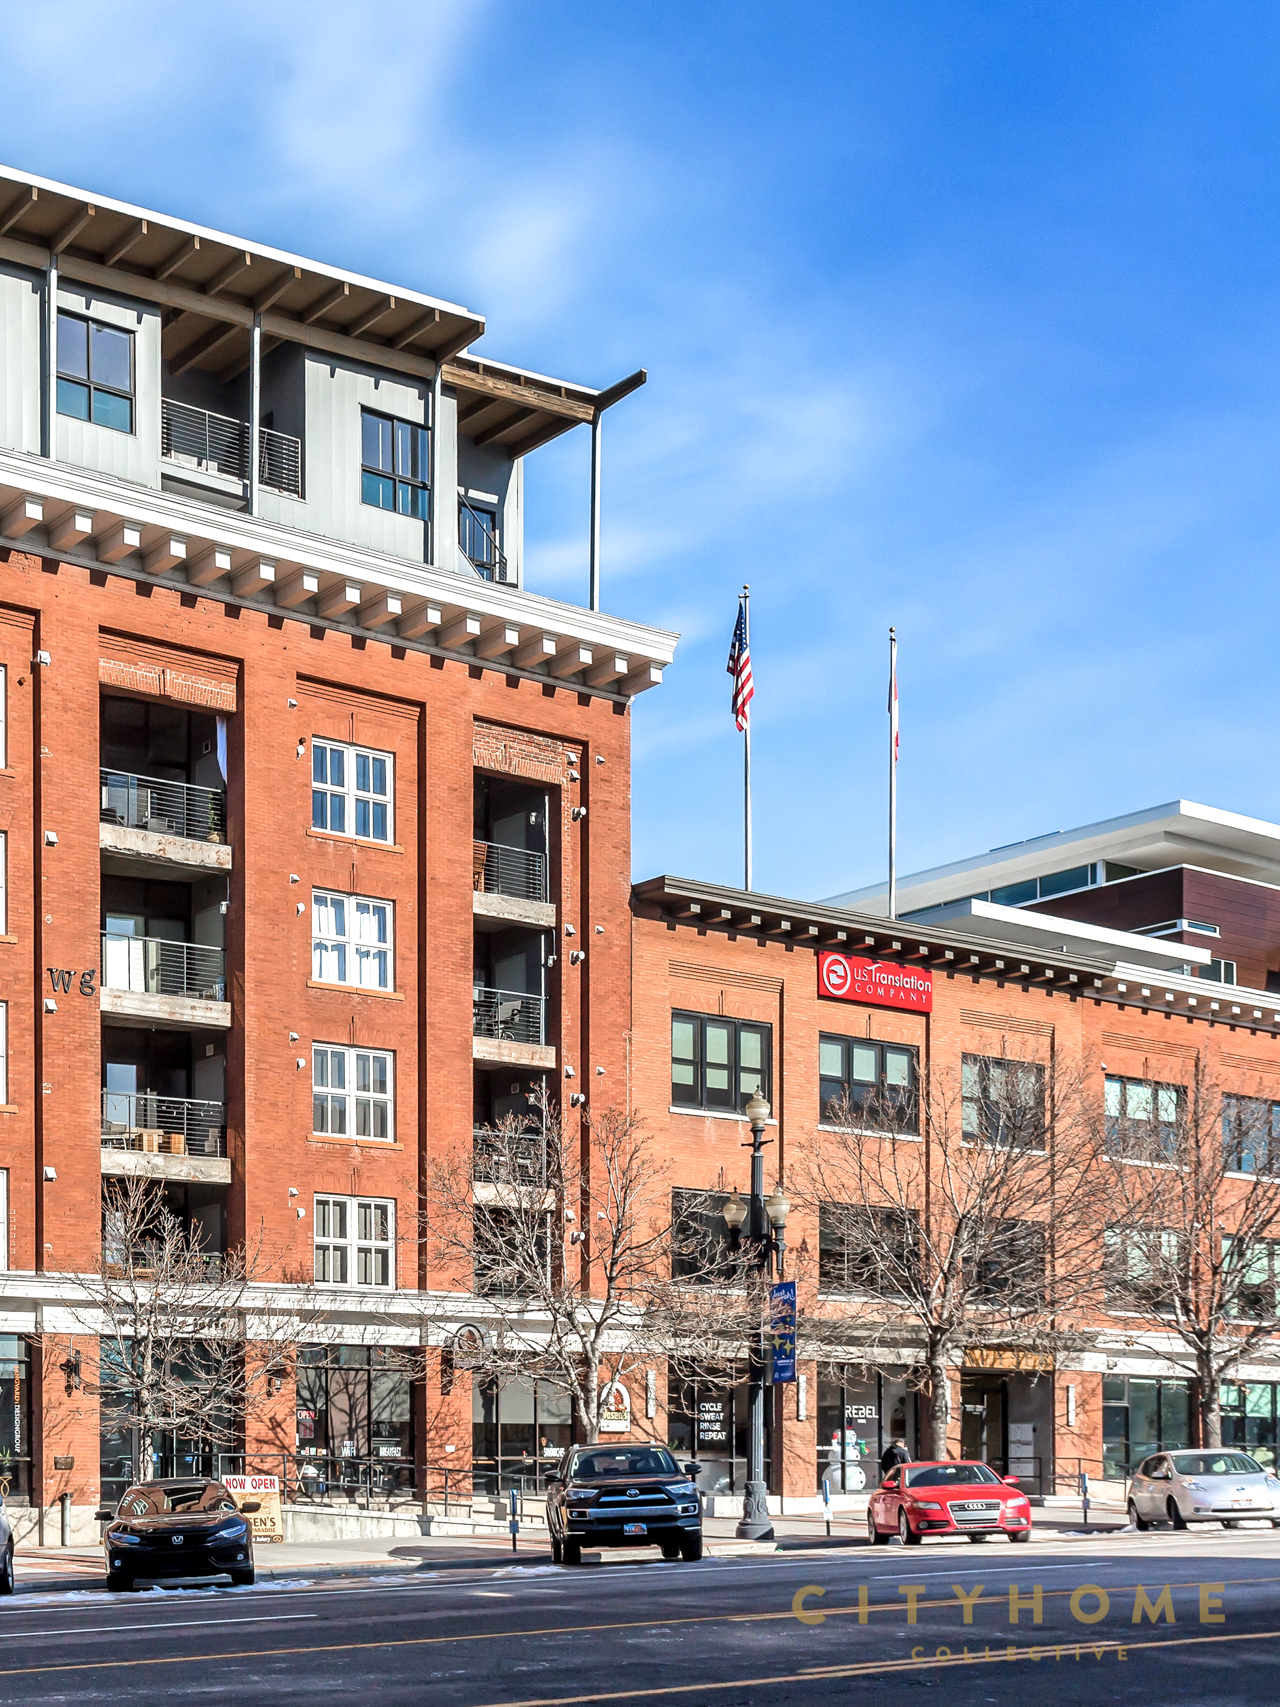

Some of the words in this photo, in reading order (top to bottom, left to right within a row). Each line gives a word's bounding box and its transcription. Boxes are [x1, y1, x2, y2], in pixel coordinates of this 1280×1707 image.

[864, 963, 932, 993] Translation
[854, 983, 927, 1004] COMPANY
[700, 1402, 723, 1411] CYCLE
[845, 1404, 879, 1419] REBEL
[297, 1410, 315, 1420] OPEN
[700, 1412, 725, 1421] SWEAT
[700, 1422, 721, 1431] RINSE
[700, 1431, 727, 1440] REPEAT
[225, 1477, 246, 1490] NOW
[250, 1477, 276, 1490] OPEN
